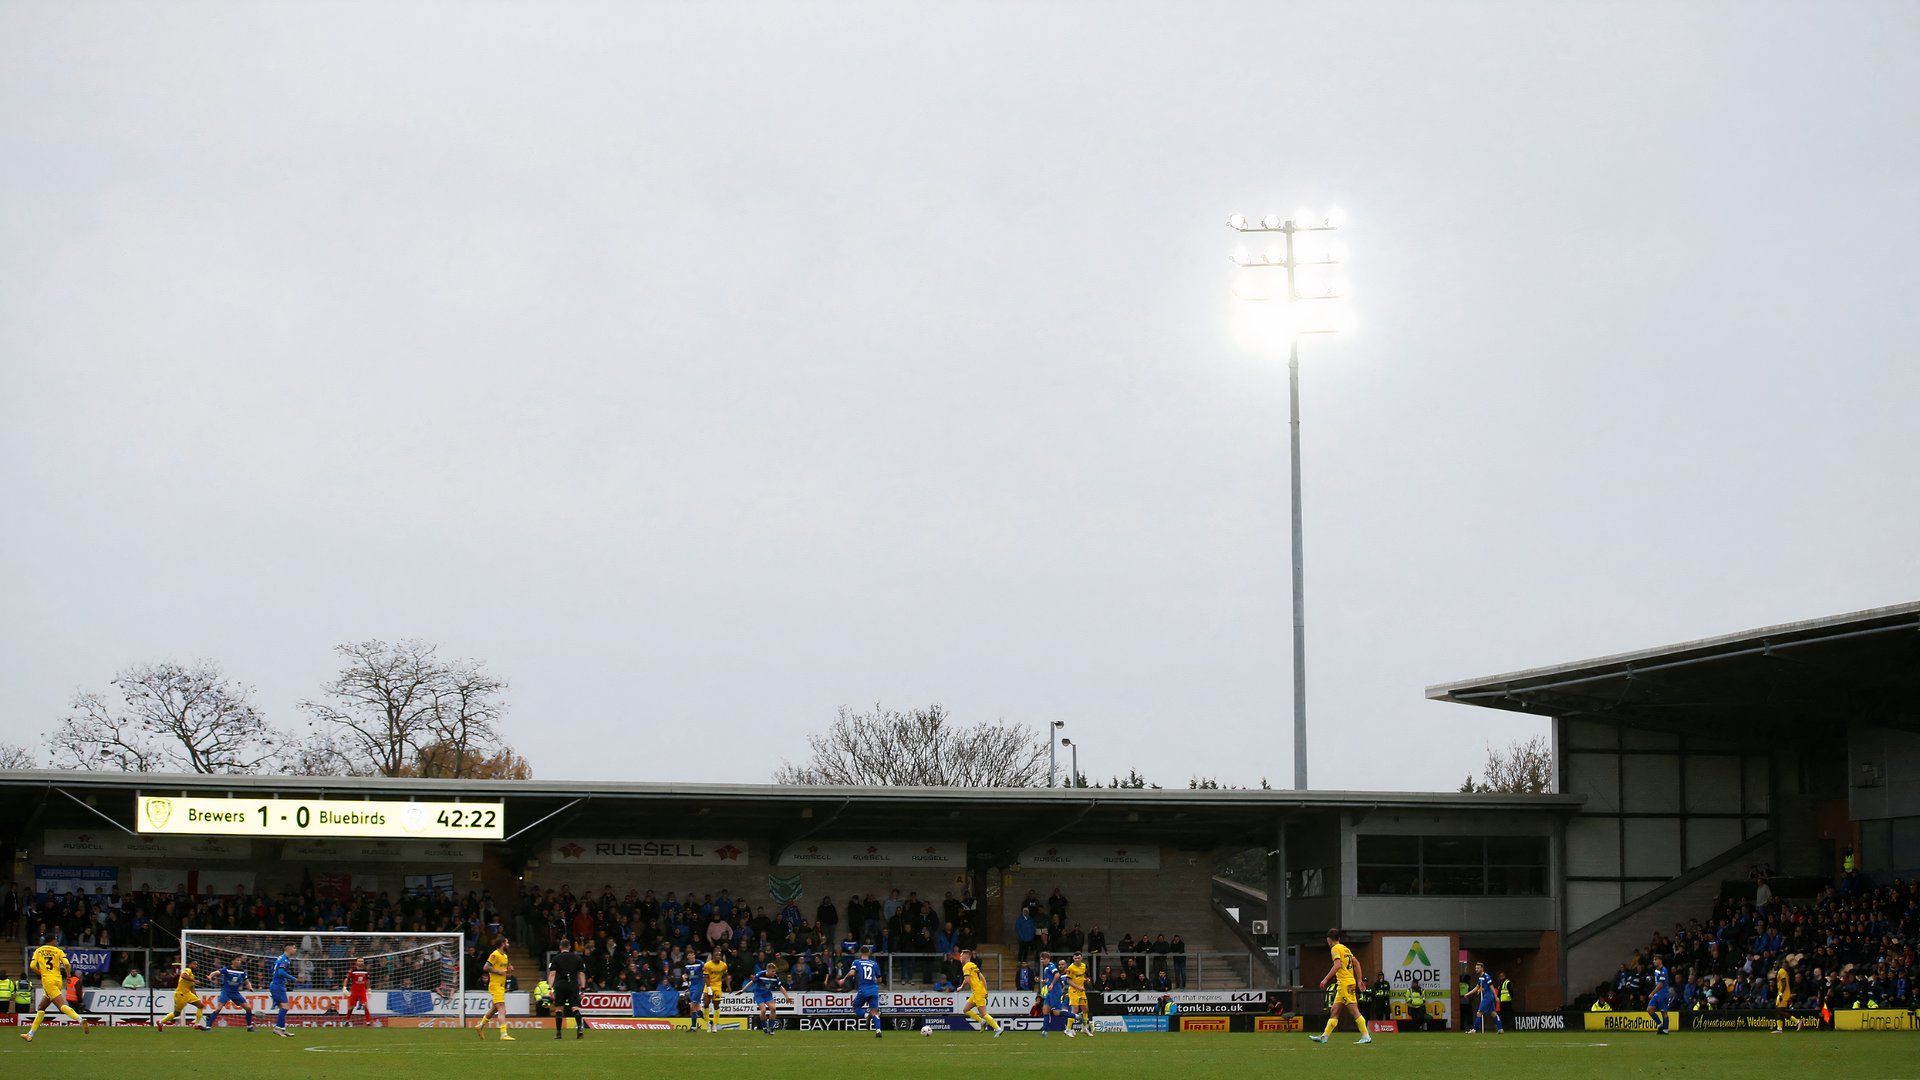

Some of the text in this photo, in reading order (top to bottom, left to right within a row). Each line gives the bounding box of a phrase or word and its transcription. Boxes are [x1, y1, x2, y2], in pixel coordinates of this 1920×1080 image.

[189, 808, 245, 822] Brewers
[257, 806, 268, 827] 1
[297, 806, 310, 828] 0
[319, 811, 386, 824] Bluebirds
[437, 810, 496, 828] 42:22
[596, 842, 704, 857] RUSSELL
[44, 956, 54, 971] 3
[70, 953, 108, 964] ARMY
[863, 966, 872, 980] 12
[1393, 969, 1440, 982] ABODE
[96, 995, 166, 1008] PRESTEC
[202, 995, 268, 1010] KTT
[802, 995, 823, 1007] Ian
[893, 994, 954, 1006] Butchers
[985, 996, 1030, 1007] AINS
[1107, 993, 1140, 1002] KIA
[1231, 992, 1263, 1001] KIA
[799, 1018, 878, 1031] BAYTREE
[1184, 1020, 1226, 1031] PIRELLI
[1515, 1015, 1564, 1030] HARDY SIGNS
[1747, 1016, 1777, 1029] Weddings
[1862, 1012, 1892, 1030] Home
[1894, 1012, 1904, 1030] of
